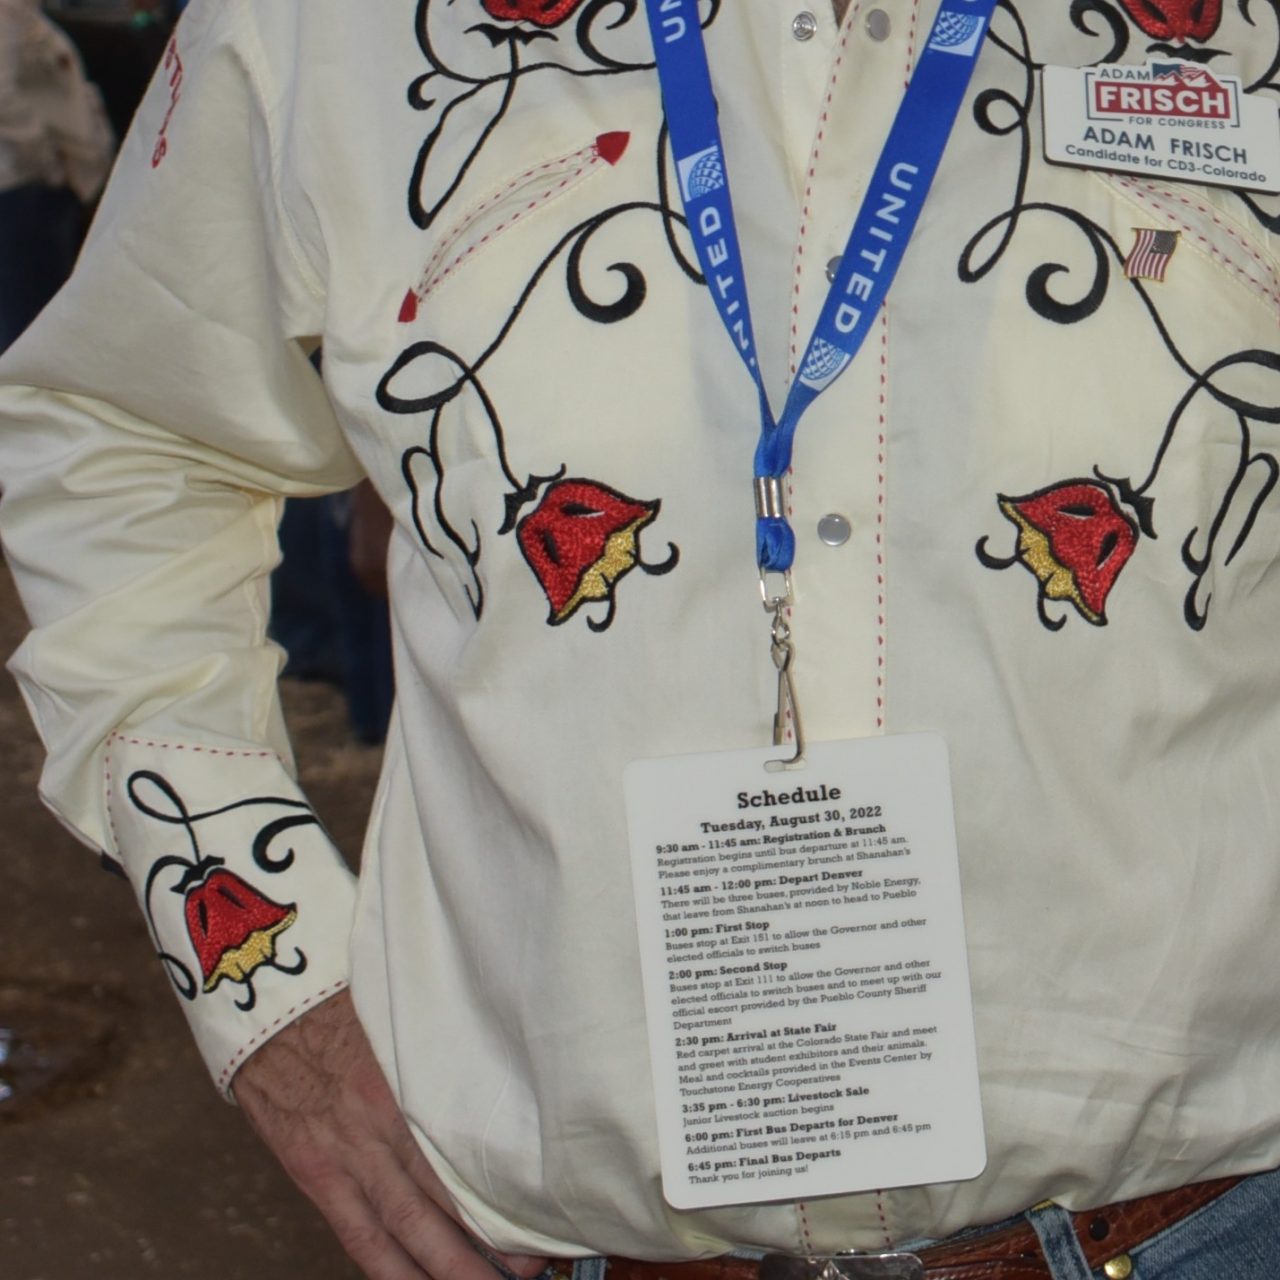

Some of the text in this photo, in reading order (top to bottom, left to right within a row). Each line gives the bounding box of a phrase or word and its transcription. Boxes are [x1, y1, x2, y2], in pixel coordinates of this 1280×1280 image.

[1100, 68, 1150, 81] ADAM
[1100, 85, 1225, 115] FRISCH
[1129, 115, 1226, 130] FOR CONGRESS
[1083, 126, 1248, 165] ADAM FRISCH
[1065, 144, 1267, 183] Candidate for CD3-Colorado
[835, 162, 919, 333] UNITED
[699, 206, 756, 367] NITED
[737, 785, 842, 809] Schedule
[699, 804, 883, 835] Tuesday, August 30, 2022
[655, 822, 887, 856] 9:30 am 11:45 am: Registration & Brunch
[656, 835, 909, 869] Registration begins until bus departure at 11:45 am.
[660, 868, 863, 898] 11:45 am 12:00 pm: Depart Denver
[660, 876, 921, 910] There will be three buses, provided by Noble Energy,
[664, 919, 770, 940] 1:00 pm: First Stop
[668, 960, 788, 982] 2:00 pm: Second Stop
[674, 1021, 837, 1049] 2:30 pm: Arrival at State Fair
[675, 1025, 937, 1061] Red carpet arrival at the Colorado State Fair and meet
[677, 1038, 926, 1074] and greet with student exhibitors and their animals.
[681, 1085, 870, 1115] 3:35 pm 6:30 pm: Livestock Sale
[682, 1103, 835, 1129] Junior Livestock auction begins
[684, 1113, 899, 1144] 6:00 pm: First Bus Departs for Denver
[686, 1122, 932, 1156] Additional buses will leave at 6:15 pm and 6:45 pm
[687, 1147, 842, 1174] 6:45 pm: Final Bus Departs
[688, 1163, 809, 1186] Thank you for joining us!
